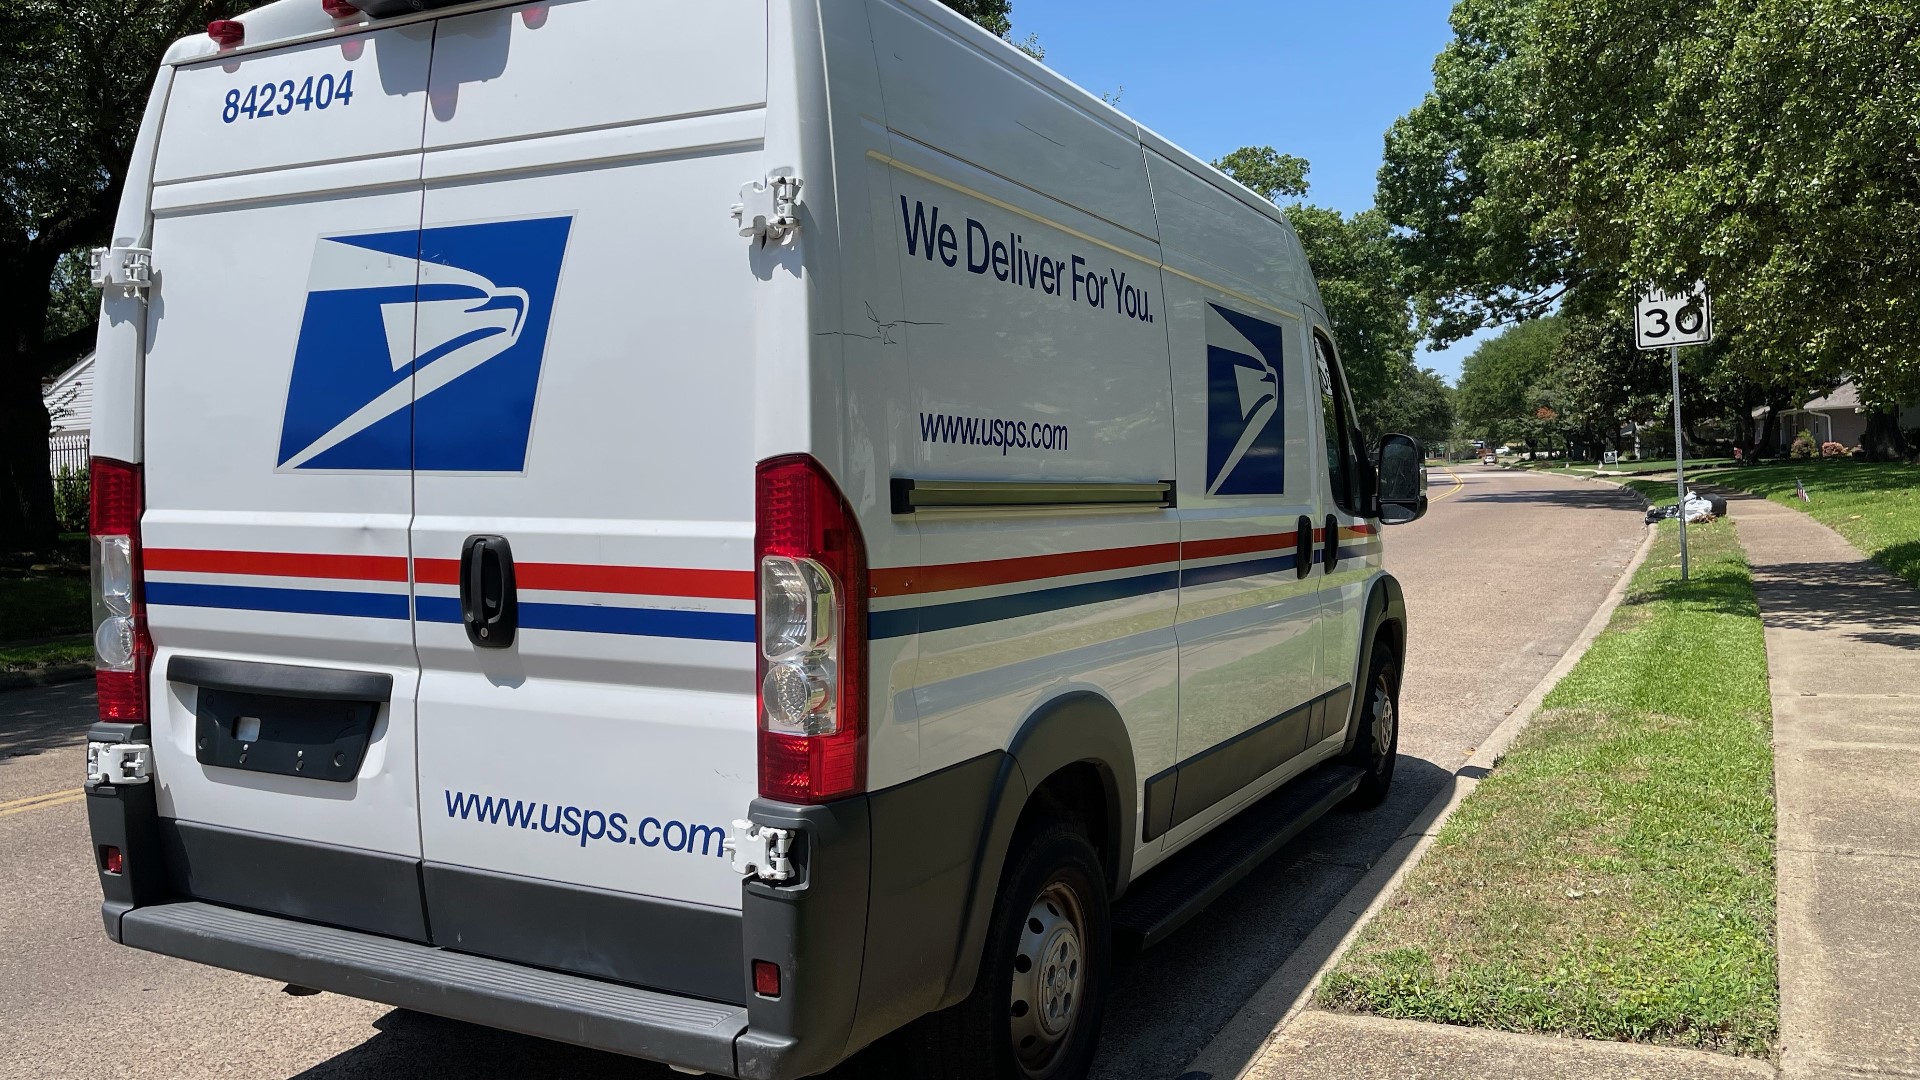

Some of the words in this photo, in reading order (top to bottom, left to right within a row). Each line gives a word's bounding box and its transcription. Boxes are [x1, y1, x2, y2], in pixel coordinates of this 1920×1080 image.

[222, 70, 353, 124] 8423404
[900, 194, 957, 267] We
[966, 218, 1065, 297] Deliver
[1071, 254, 1108, 310] For
[1111, 268, 1153, 323] You.
[1648, 289, 1692, 303] LIMI
[1644, 305, 1704, 338] 30
[919, 412, 1068, 456] www.usps.com
[445, 790, 726, 858] www.usps.com
